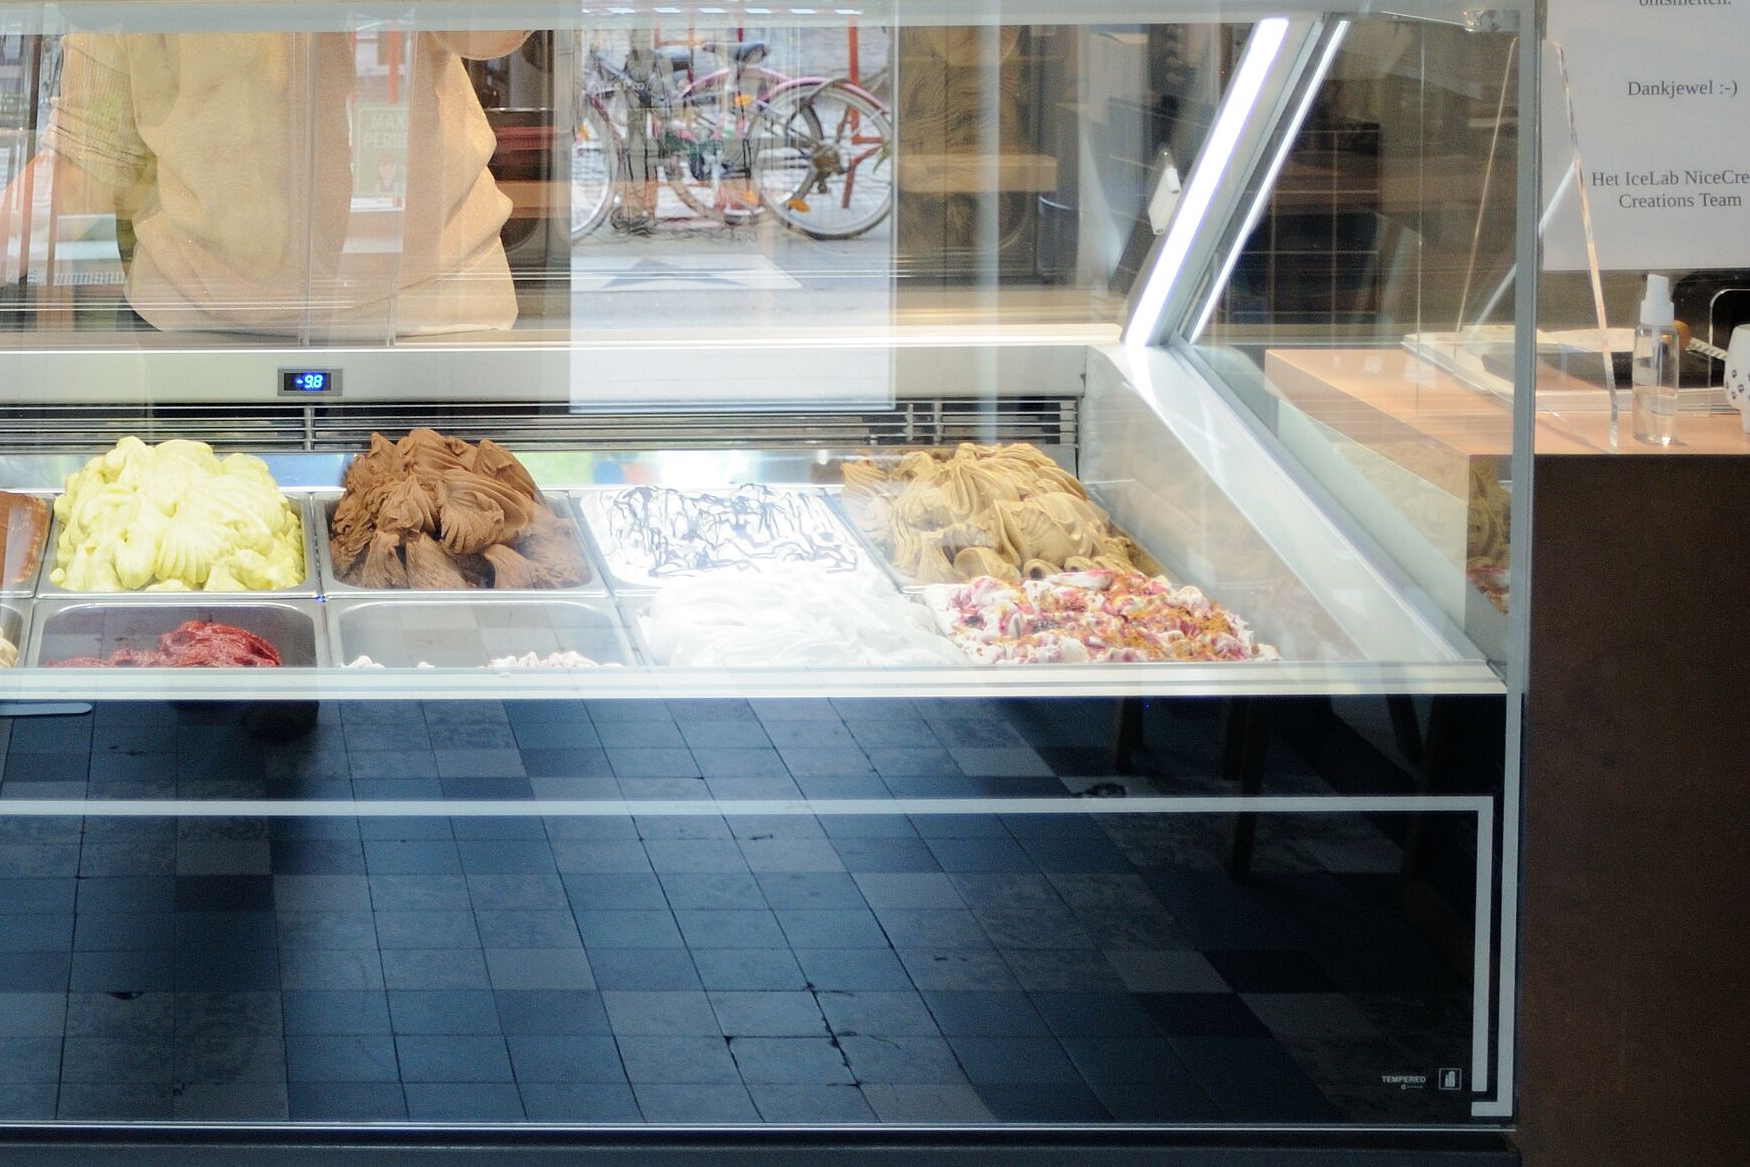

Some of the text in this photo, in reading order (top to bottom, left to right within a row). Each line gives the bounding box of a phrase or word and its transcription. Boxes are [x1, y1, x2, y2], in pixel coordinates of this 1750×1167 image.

[1628, 80, 1738, 99] Dankjewel :-)
[1592, 172, 1619, 186] Het
[1625, 170, 1679, 186] IceLab
[1619, 193, 1742, 209] Creations Team
[1381, 1075, 1427, 1083] TEMPERED
